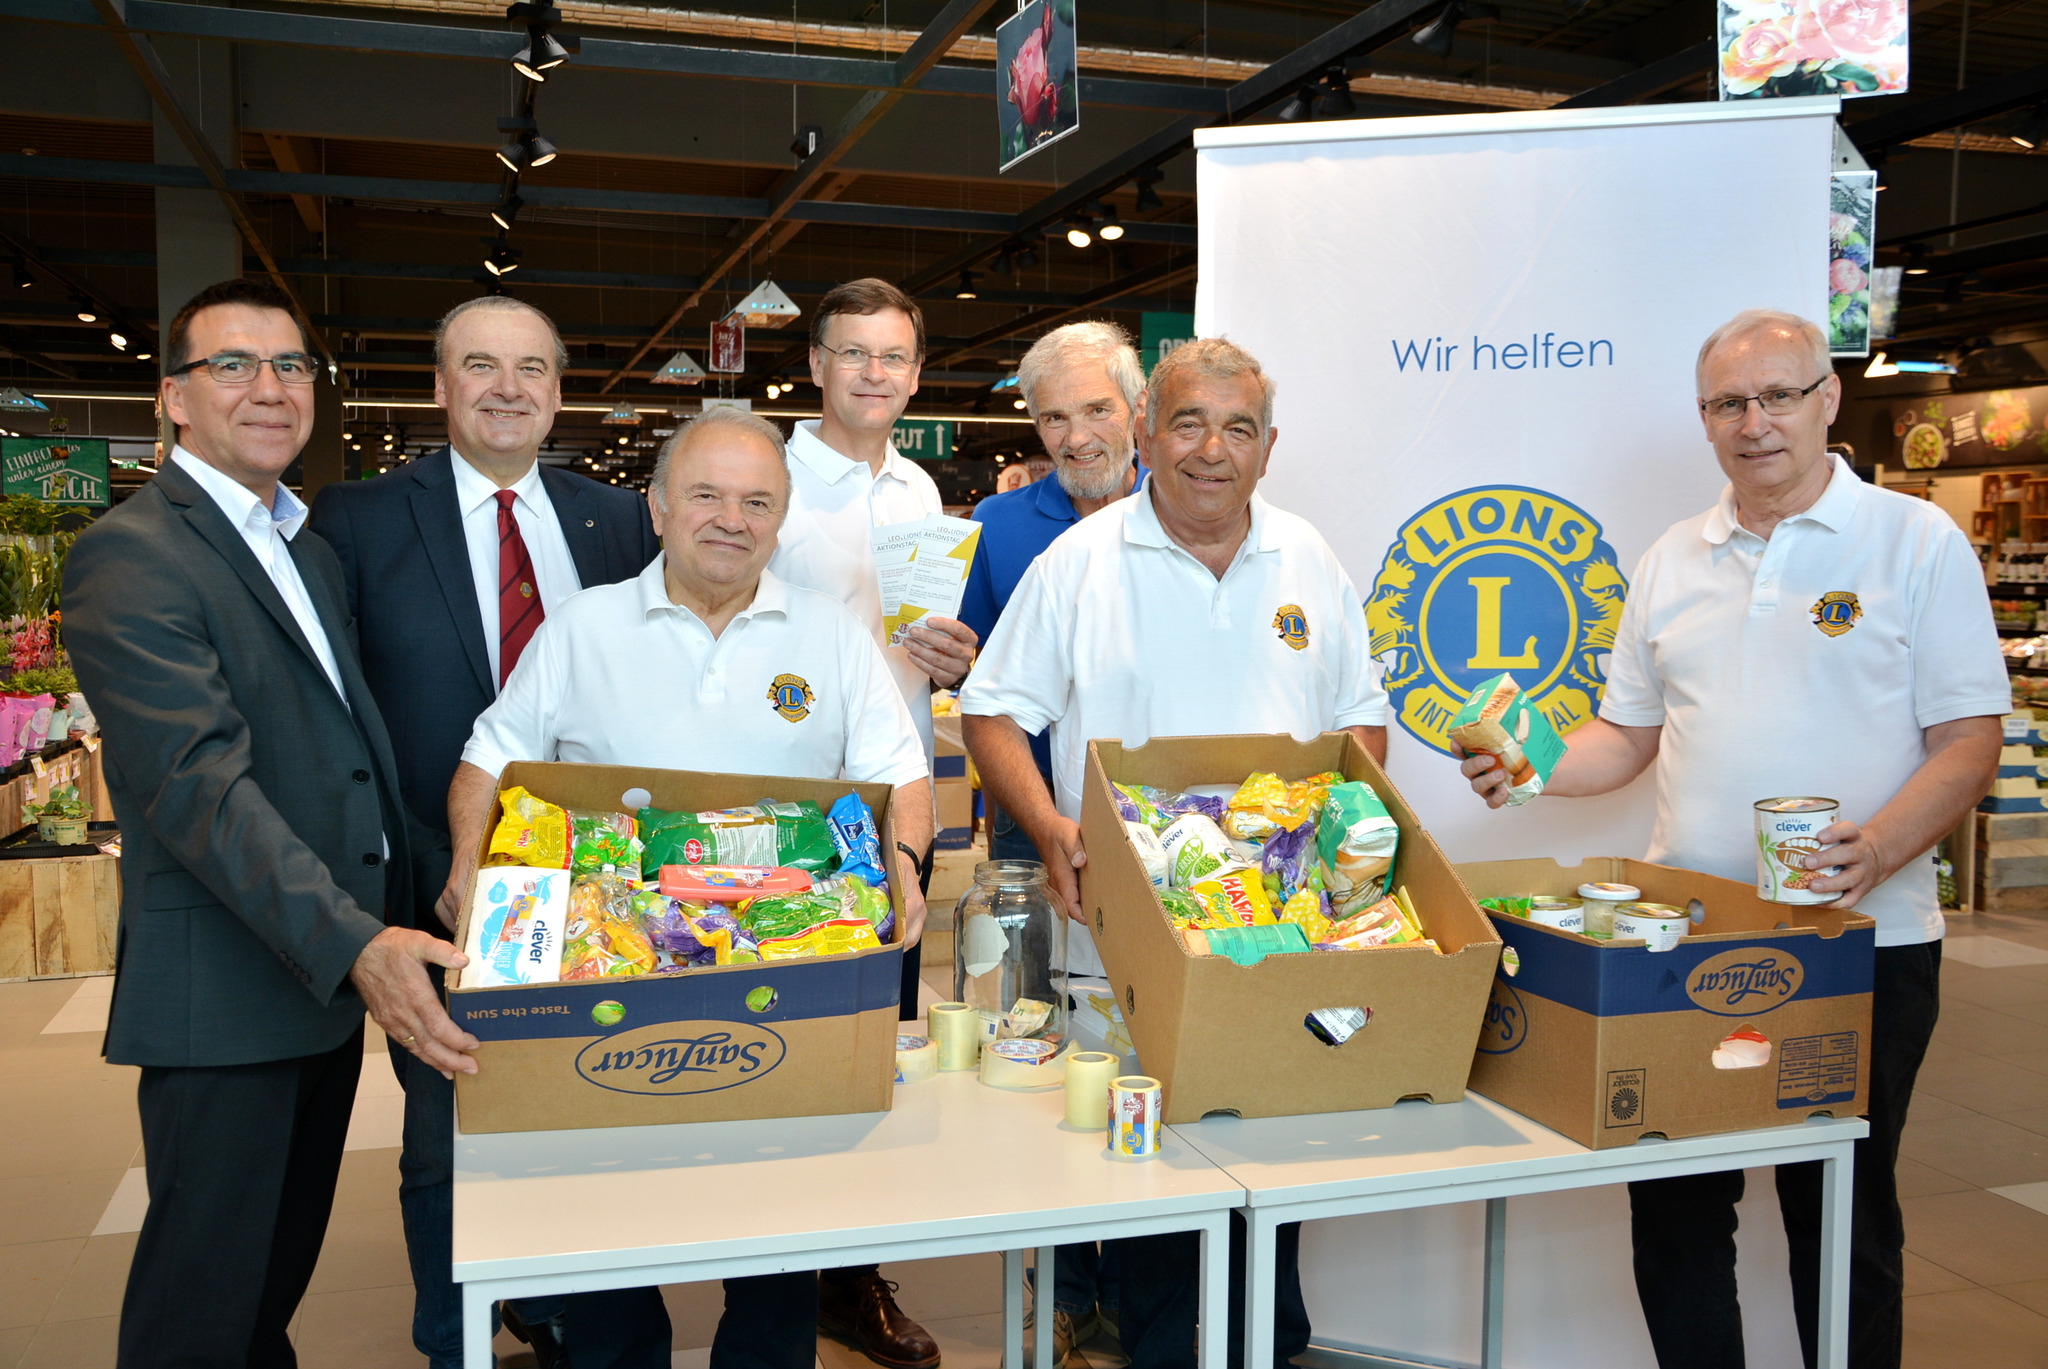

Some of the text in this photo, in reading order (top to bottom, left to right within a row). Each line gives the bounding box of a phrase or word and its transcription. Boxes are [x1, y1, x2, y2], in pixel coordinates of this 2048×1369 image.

[1391, 333, 1613, 373] Wir helfen
[890, 428, 925, 450] GUT
[7, 460, 66, 482] unter einem
[1414, 497, 1587, 558] LIONS
[877, 541, 917, 552] AKTIONSTAG
[923, 532, 961, 544] AKTIONSTAG
[1466, 577, 1540, 669] L
[1828, 605, 1845, 623] L
[1287, 617, 1303, 636] L
[776, 676, 805, 686] LIONS
[783, 688, 799, 706] L
[1775, 821, 1812, 832] clever
[1176, 849, 1200, 873] ERBSEN
[1783, 850, 1806, 869] LINS
[1559, 916, 1582, 928] clever
[530, 919, 548, 964] clever
[466, 1003, 571, 1020] Taste the SUN
